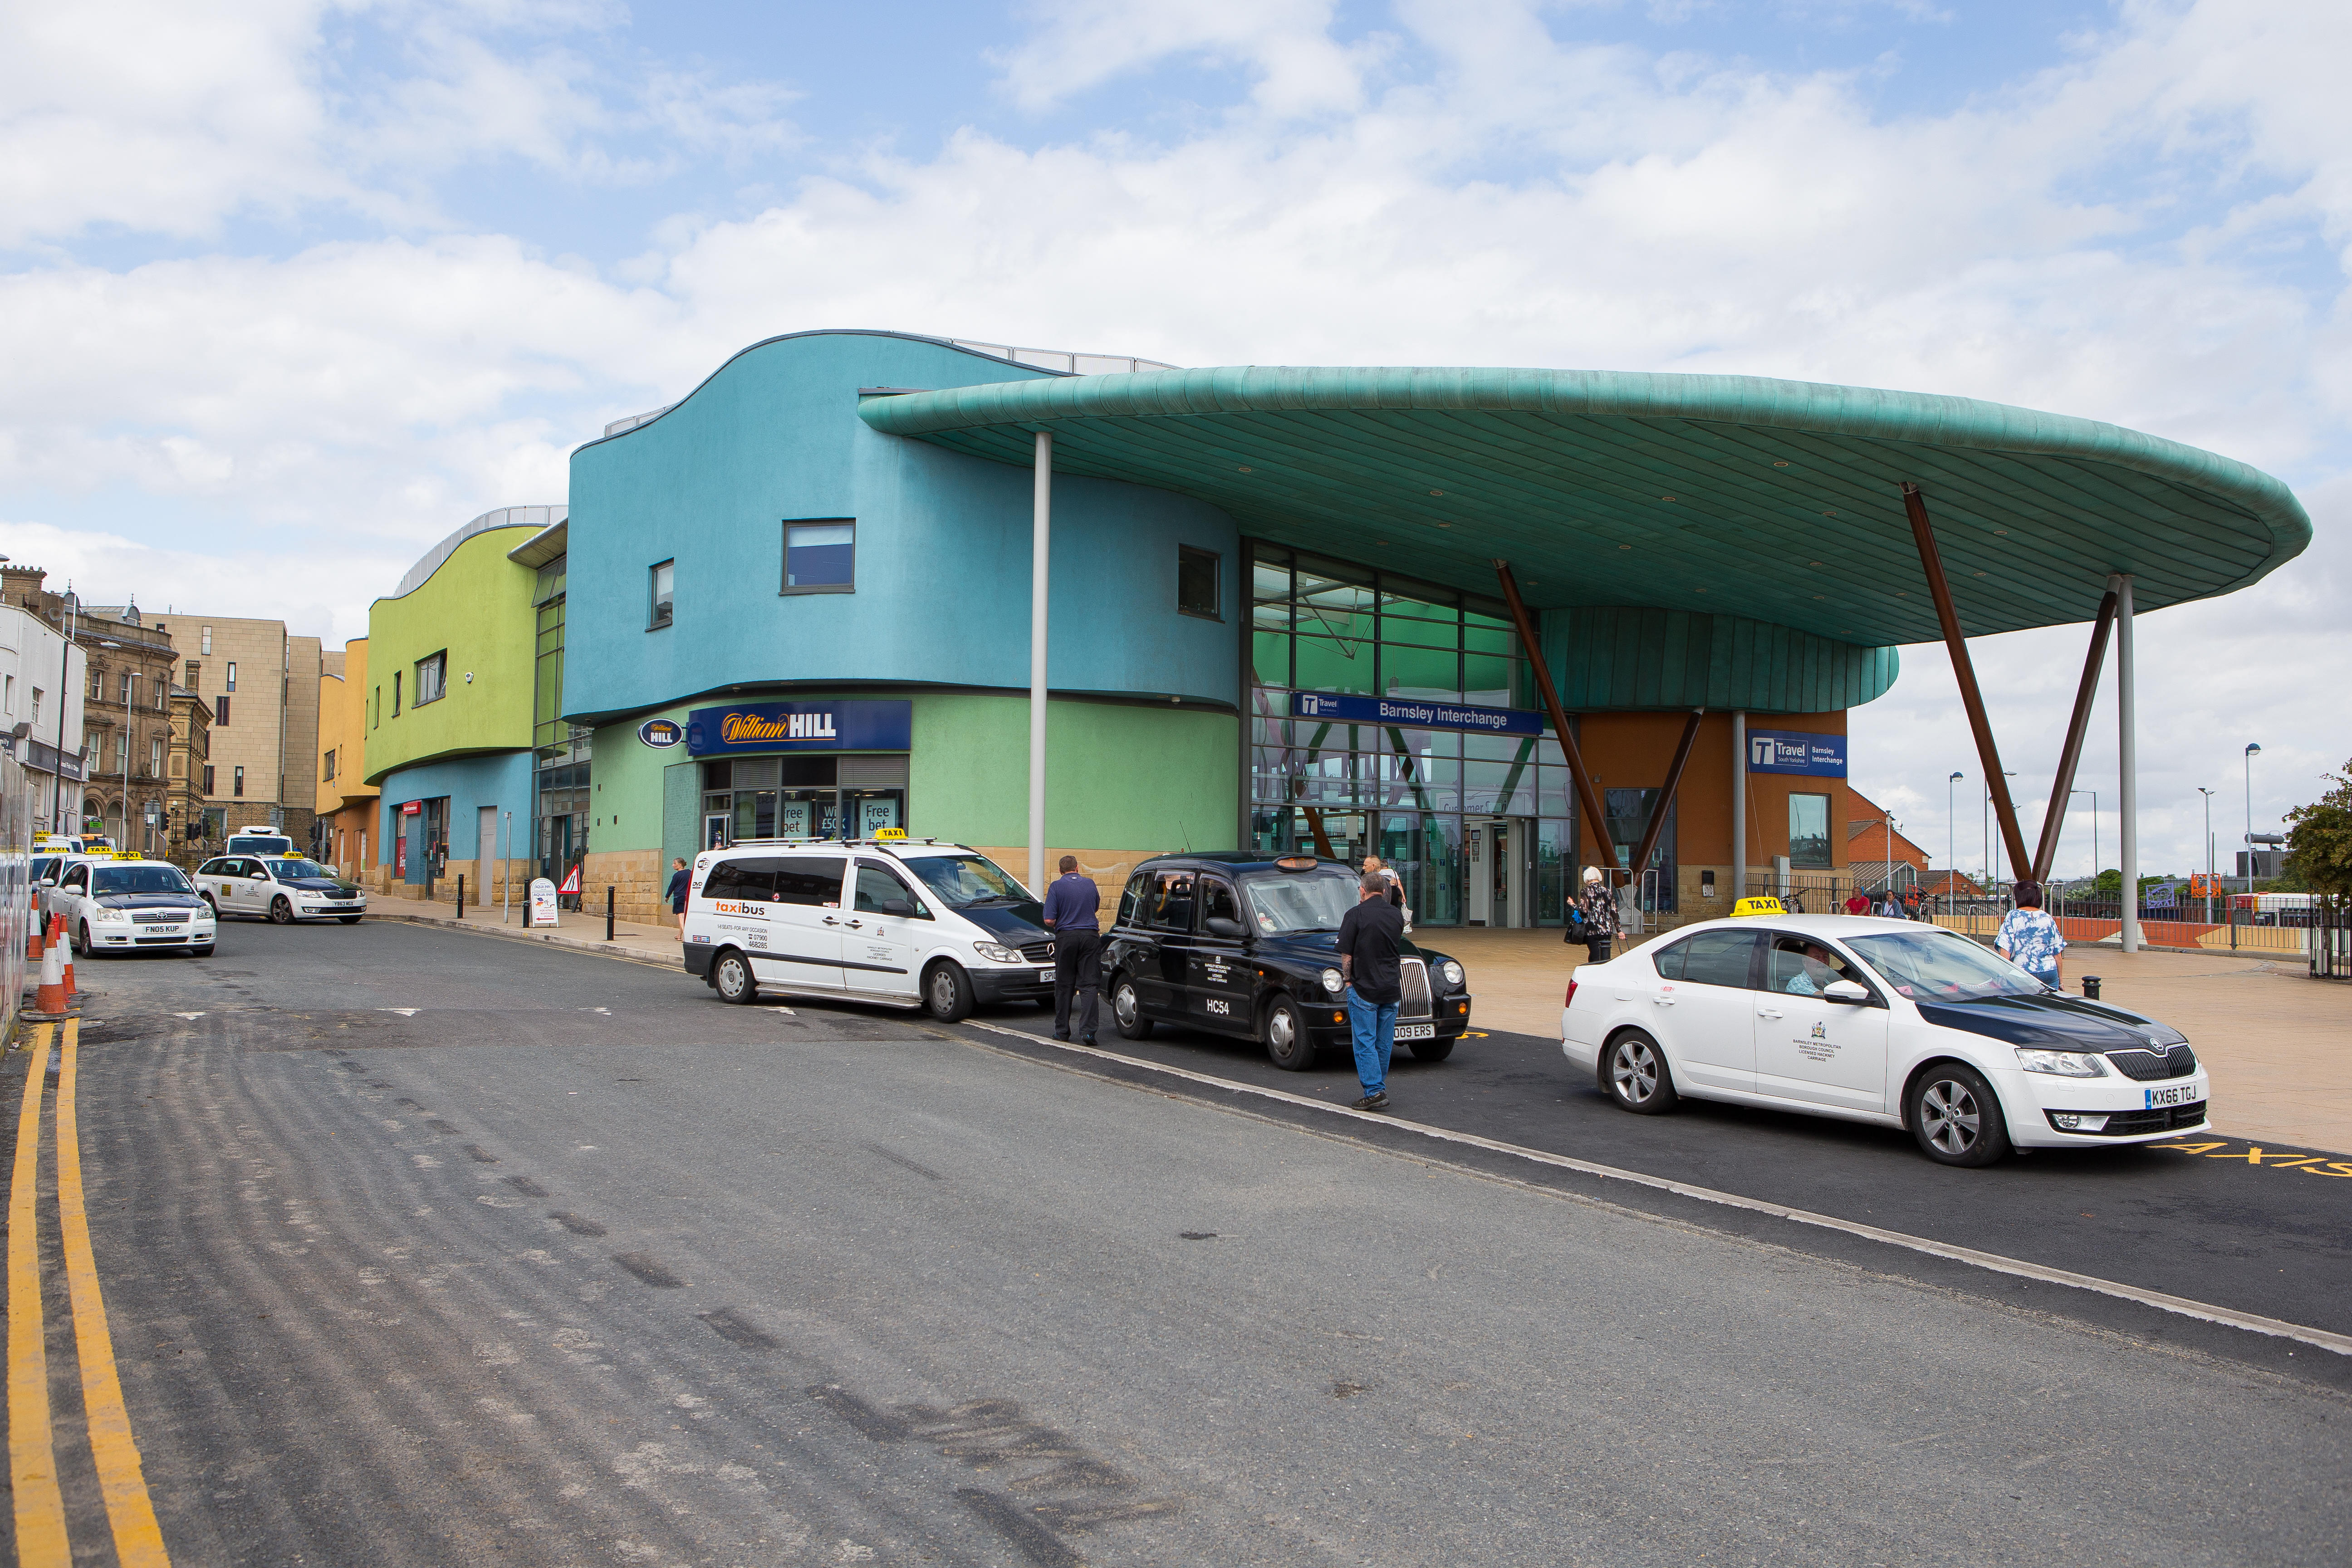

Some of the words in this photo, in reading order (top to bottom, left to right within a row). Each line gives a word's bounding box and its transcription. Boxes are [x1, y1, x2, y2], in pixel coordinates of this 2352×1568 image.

[1319, 699, 1337, 707] Travel
[1380, 703, 1433, 723] Barnsley
[1437, 708, 1507, 729] Interchange
[651, 724, 673, 732] William
[721, 713, 789, 741] William
[789, 714, 836, 737] HILL
[651, 732, 673, 742] HILL
[1776, 743, 1805, 756] Travel
[1812, 746, 1834, 756] Barnsley
[1812, 755, 1842, 765] Interchange
[824, 806, 836, 817] Wi
[866, 805, 889, 817] Free
[868, 818, 887, 831] bet
[716, 901, 765, 915] taxibus
[1748, 900, 1778, 909] TAXI
[1207, 999, 1229, 1015] HC54
[1414, 1025, 1431, 1037] ERS
[2152, 1088, 2178, 1106] KX66
[2180, 1085, 2196, 1102] TGJ
[2145, 1142, 2352, 1177] AXIS
